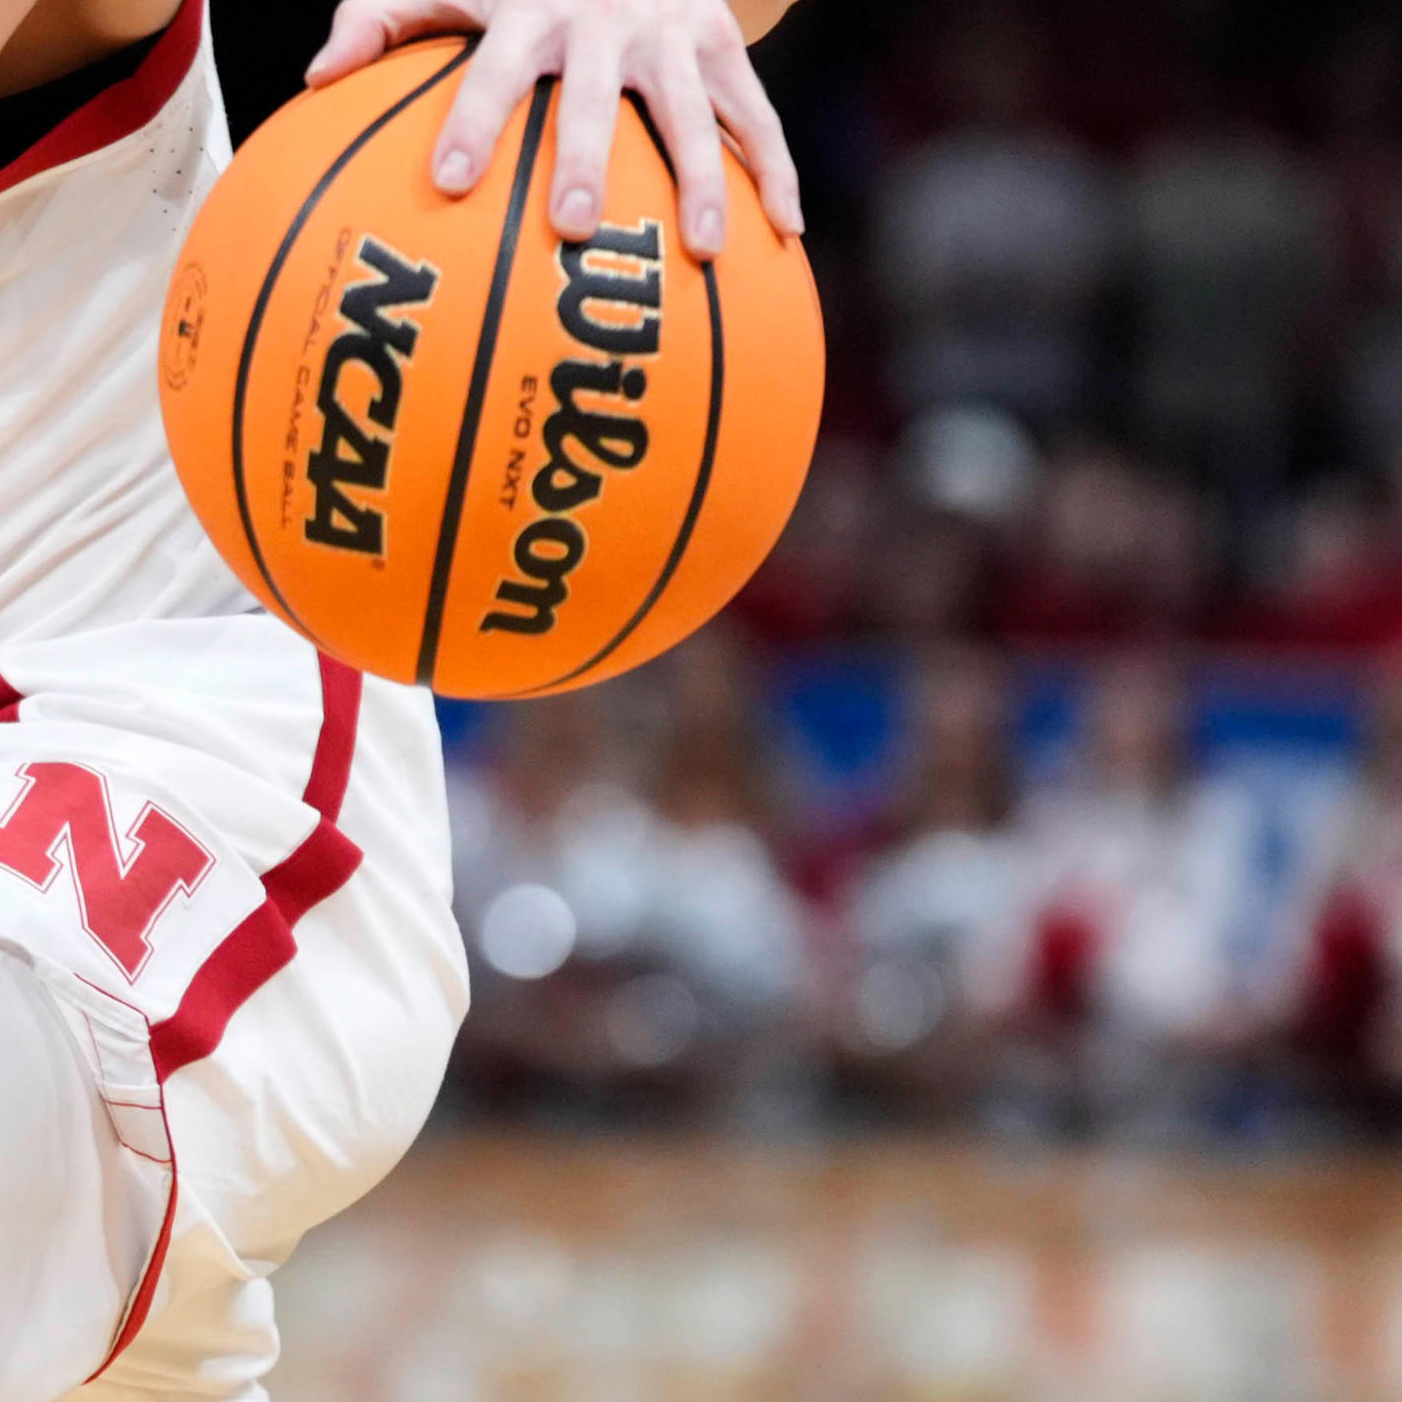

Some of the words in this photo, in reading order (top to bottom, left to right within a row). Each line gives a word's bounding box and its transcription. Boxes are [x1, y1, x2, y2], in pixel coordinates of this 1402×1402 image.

[304, 232, 441, 558] NCAA
[478, 216, 664, 638] Wilson
[498, 447, 526, 510] NXT
[513, 375, 538, 439] EVO
